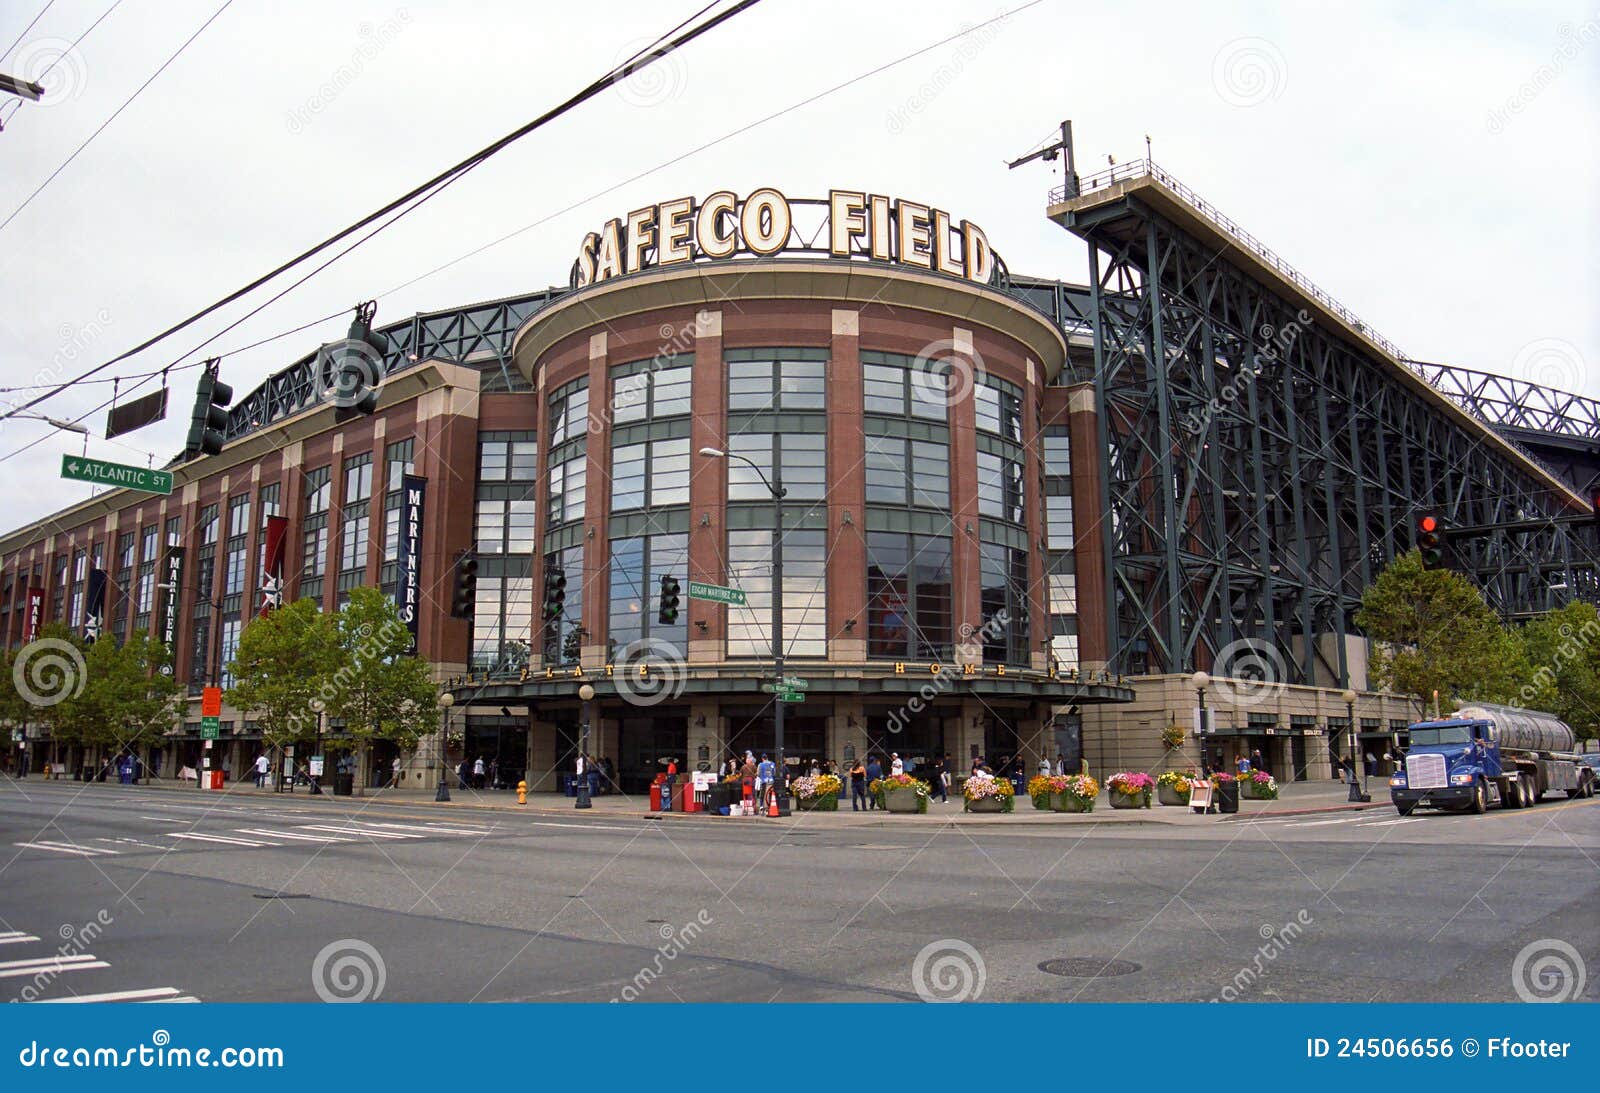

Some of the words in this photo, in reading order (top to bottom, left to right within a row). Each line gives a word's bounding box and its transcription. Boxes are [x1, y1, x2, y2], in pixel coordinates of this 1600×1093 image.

[576, 187, 792, 287] SAFECO
[829, 189, 993, 284] FIELD
[83, 463, 145, 485] ATLANTIC
[153, 476, 166, 486] ST
[405, 489, 421, 623] MARINERS
[29, 595, 40, 643] MARIN
[165, 556, 180, 655] MARINERS
[520, 664, 649, 682] PLATE
[895, 662, 1006, 676] HOME
